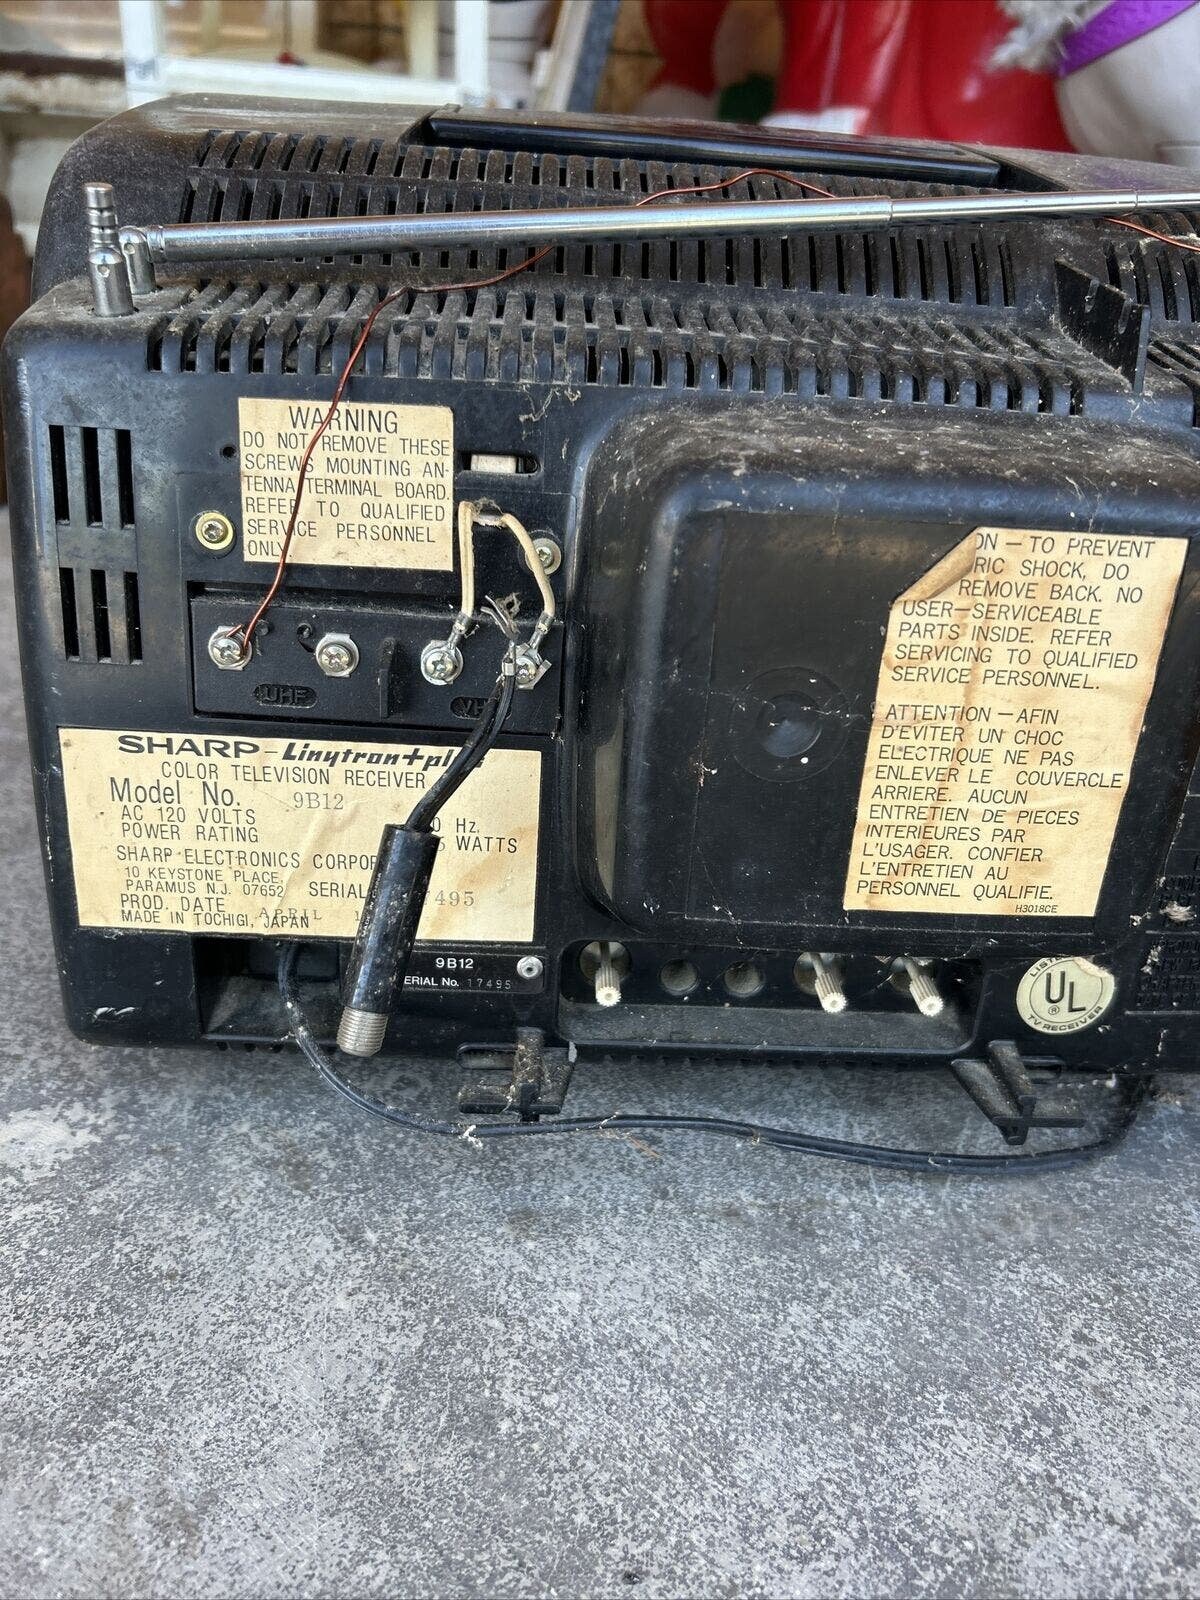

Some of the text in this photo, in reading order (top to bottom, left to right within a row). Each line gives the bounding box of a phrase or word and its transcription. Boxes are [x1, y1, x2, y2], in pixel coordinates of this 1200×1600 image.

[289, 405, 398, 433] WARNING
[243, 431, 450, 456] DO NOT REMOVE THESE
[245, 453, 450, 478] SCREWS MOUNTING AN-
[244, 475, 450, 501] TENNA TERMINAL BOARD.
[316, 501, 340, 518] TO
[361, 502, 445, 522] QUALIFIED
[336, 523, 436, 543] PERSONNEL
[1030, 536, 1055, 554] TO
[1067, 538, 1155, 559] PREVENT
[973, 557, 1130, 581] RIC SHOCK, DO
[958, 579, 1143, 604] REMOVE BACK. NO
[898, 621, 1111, 646] PARTS INSIDE. REFER
[895, 643, 1138, 670] SERVICING TO QUALIFIED
[891, 665, 1100, 691] SERVICE PERSONNEL.
[264, 686, 308, 704] UHF
[459, 698, 487, 715] VH
[885, 703, 991, 723] ATTENTION
[1016, 708, 1059, 725] AFIN
[881, 725, 1064, 746] D'EVITER UN CHOC
[118, 734, 260, 759] SHARP
[282, 742, 485, 772] Linytron+pl
[879, 744, 1075, 767] ELECTRIQUE NE PAS
[161, 761, 426, 789] COLOR TELEVISION RECEIVER
[875, 765, 1123, 789] ENLEVER LE COUVERCLE
[110, 777, 344, 811] Model No. 9B12
[871, 784, 1028, 805] ARRIERE. AUCUN
[121, 804, 256, 825] AC 120 VOLTS
[431, 816, 481, 834] 0 Hz.
[869, 804, 1080, 826] ENTRETIEN DE PIECES
[122, 822, 259, 843] POWER RATING
[865, 824, 1026, 843] INTERIEURES PAR
[456, 835, 518, 854] WATTS
[863, 843, 1043, 862] L'USAGER. CONFIER
[116, 845, 173, 862] SHARP
[185, 848, 300, 868] ELECTRONICS
[124, 866, 140, 878] 10
[148, 867, 224, 882] KEYSTONE
[860, 861, 1009, 881] L'ENTRETIEN AU
[126, 879, 284, 898] PARAMUS N.J. 07652
[308, 882, 475, 907] SERIAL 495
[856, 880, 1054, 901] PERSONNEL QUALIFIE.
[121, 893, 169, 910] PROD.
[181, 896, 226, 913] DATE
[259, 907, 322, 921] APRIL
[1014, 904, 1058, 914] H3018CE
[122, 910, 309, 929] MADE IN TOCHIGI, JAPAN
[436, 958, 474, 969] 9B12
[404, 976, 511, 990] ERIAL No. 17495
[1045, 970, 1086, 1012] UL
[1028, 1005, 1103, 1031] TV RECEIVER
